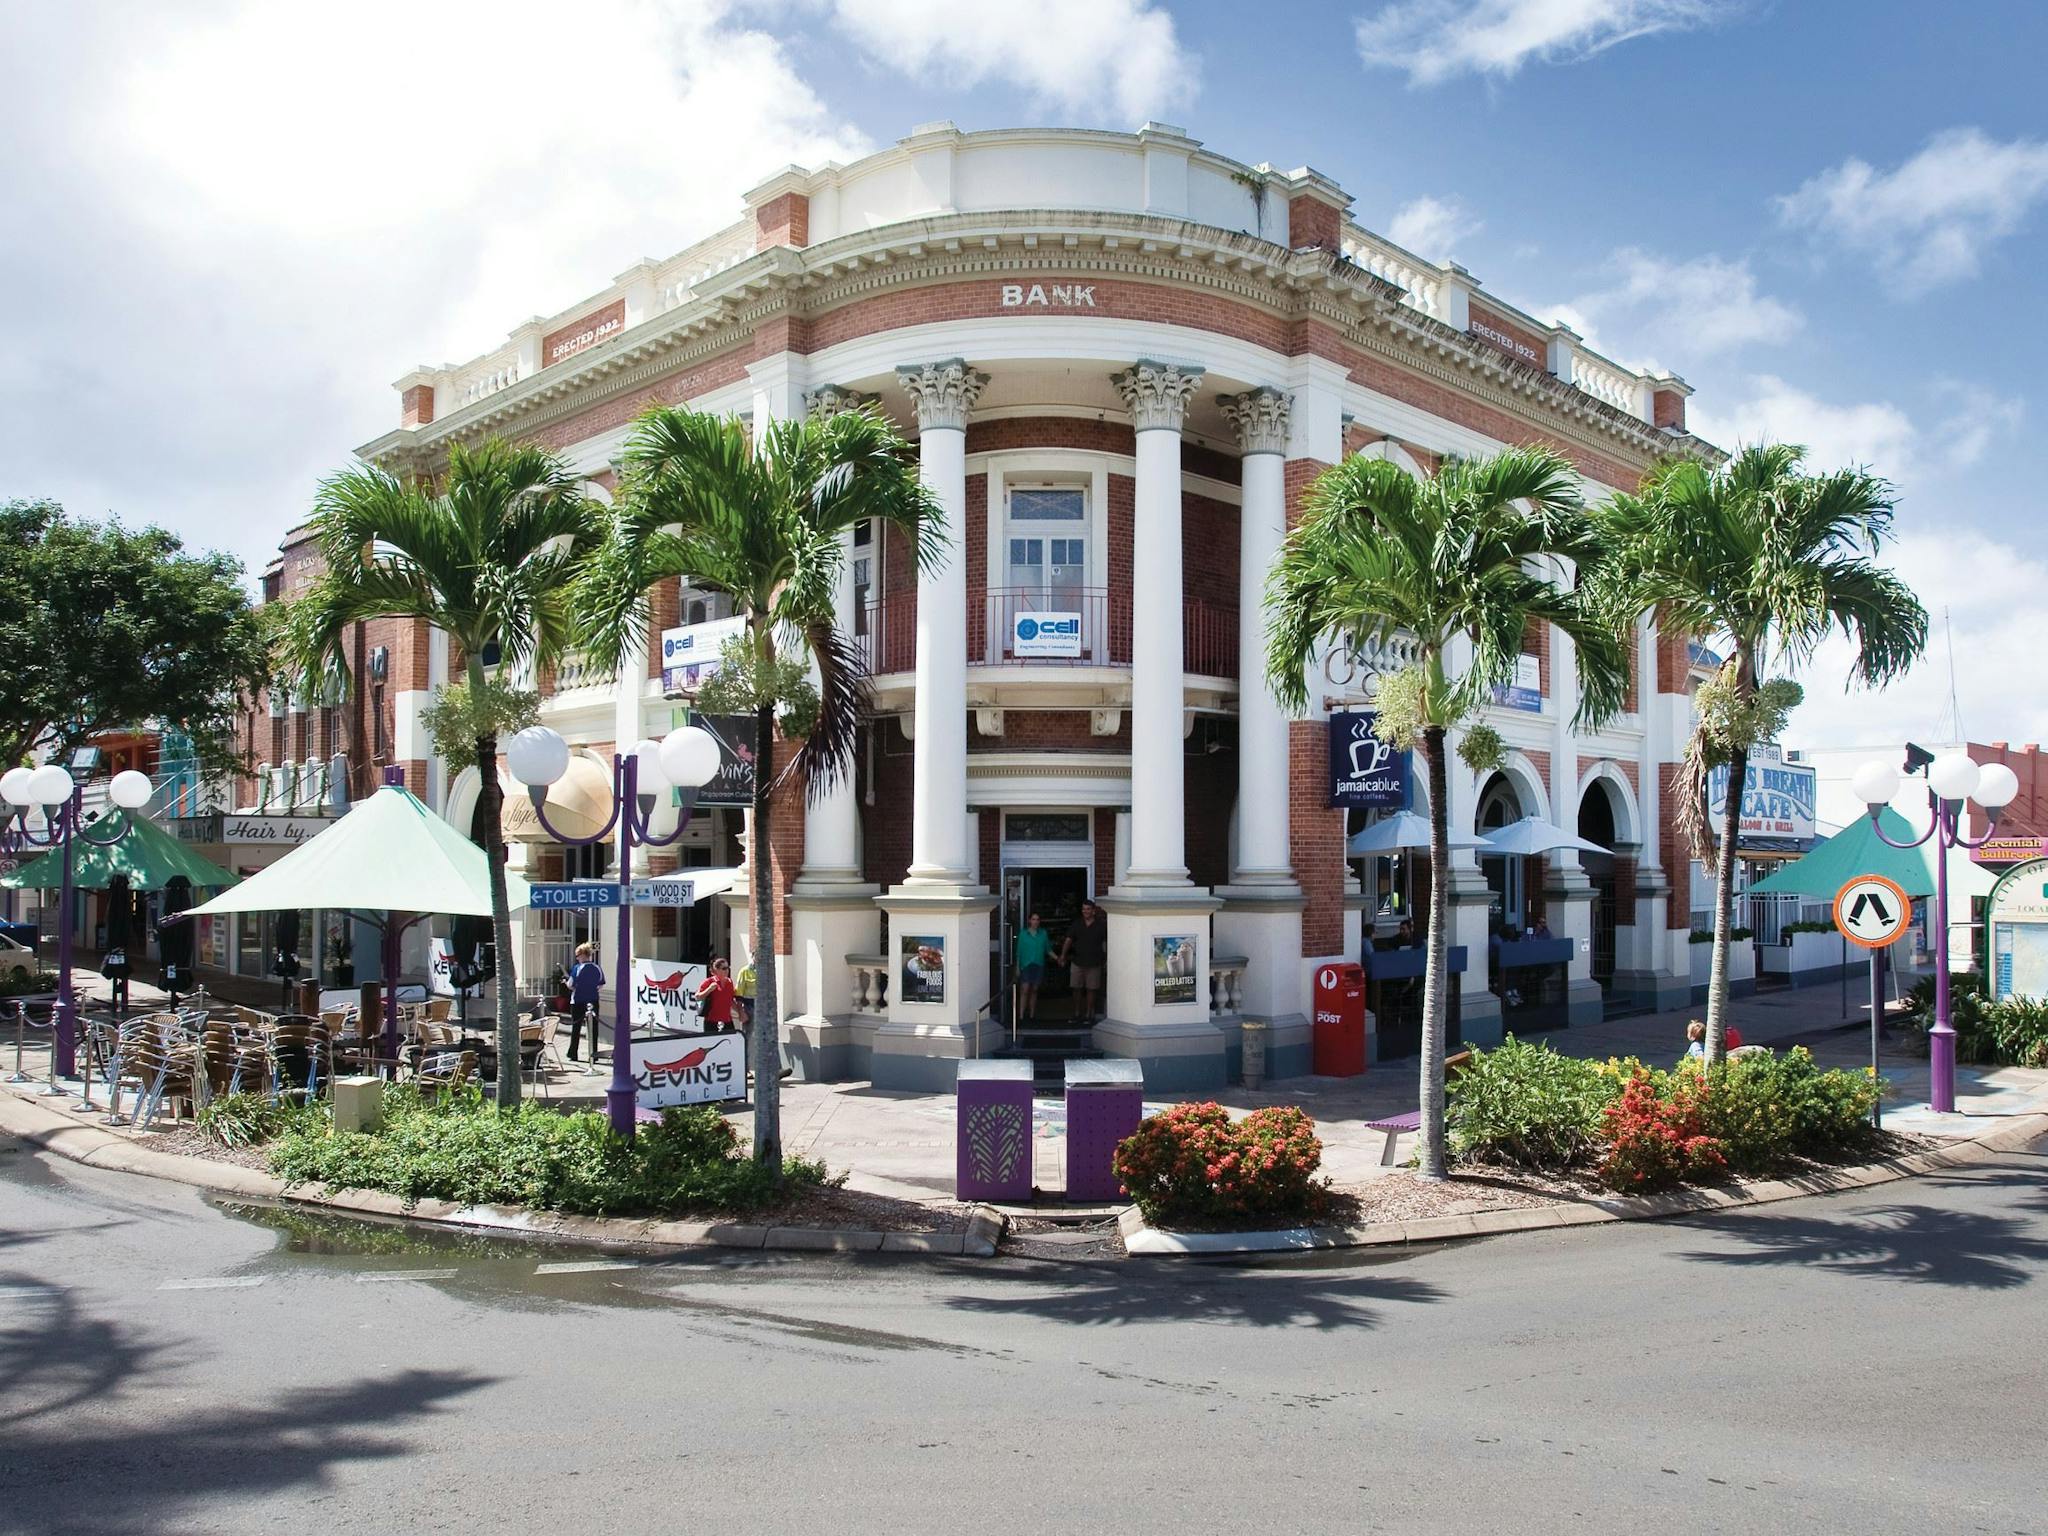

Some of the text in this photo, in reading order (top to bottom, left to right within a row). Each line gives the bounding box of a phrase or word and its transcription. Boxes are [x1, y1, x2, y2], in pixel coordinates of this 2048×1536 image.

[1002, 284, 1096, 307] BANK
[1472, 320, 1513, 349] ERECTED
[552, 330, 594, 358] ERECTED
[1040, 619, 1079, 633] cell
[675, 634, 694, 650] cell
[1039, 634, 1079, 642] consultancy
[1752, 747, 1764, 758] EST
[1335, 777, 1400, 796] jamaicablue
[1761, 768, 1814, 813] BREATH
[1741, 792, 1792, 820] CAFE
[227, 821, 277, 839] Hair
[1740, 819, 1763, 831] ALOON
[652, 884, 692, 898] WOOD ST
[1996, 863, 2046, 903] CITY OF
[542, 888, 609, 904] TOILETS
[658, 896, 685, 905] 98-31
[637, 986, 698, 1011] KEVIN'S
[638, 1007, 700, 1027] PACE
[1317, 1013, 1342, 1024] POST
[632, 1062, 732, 1091] KEVIN'S
